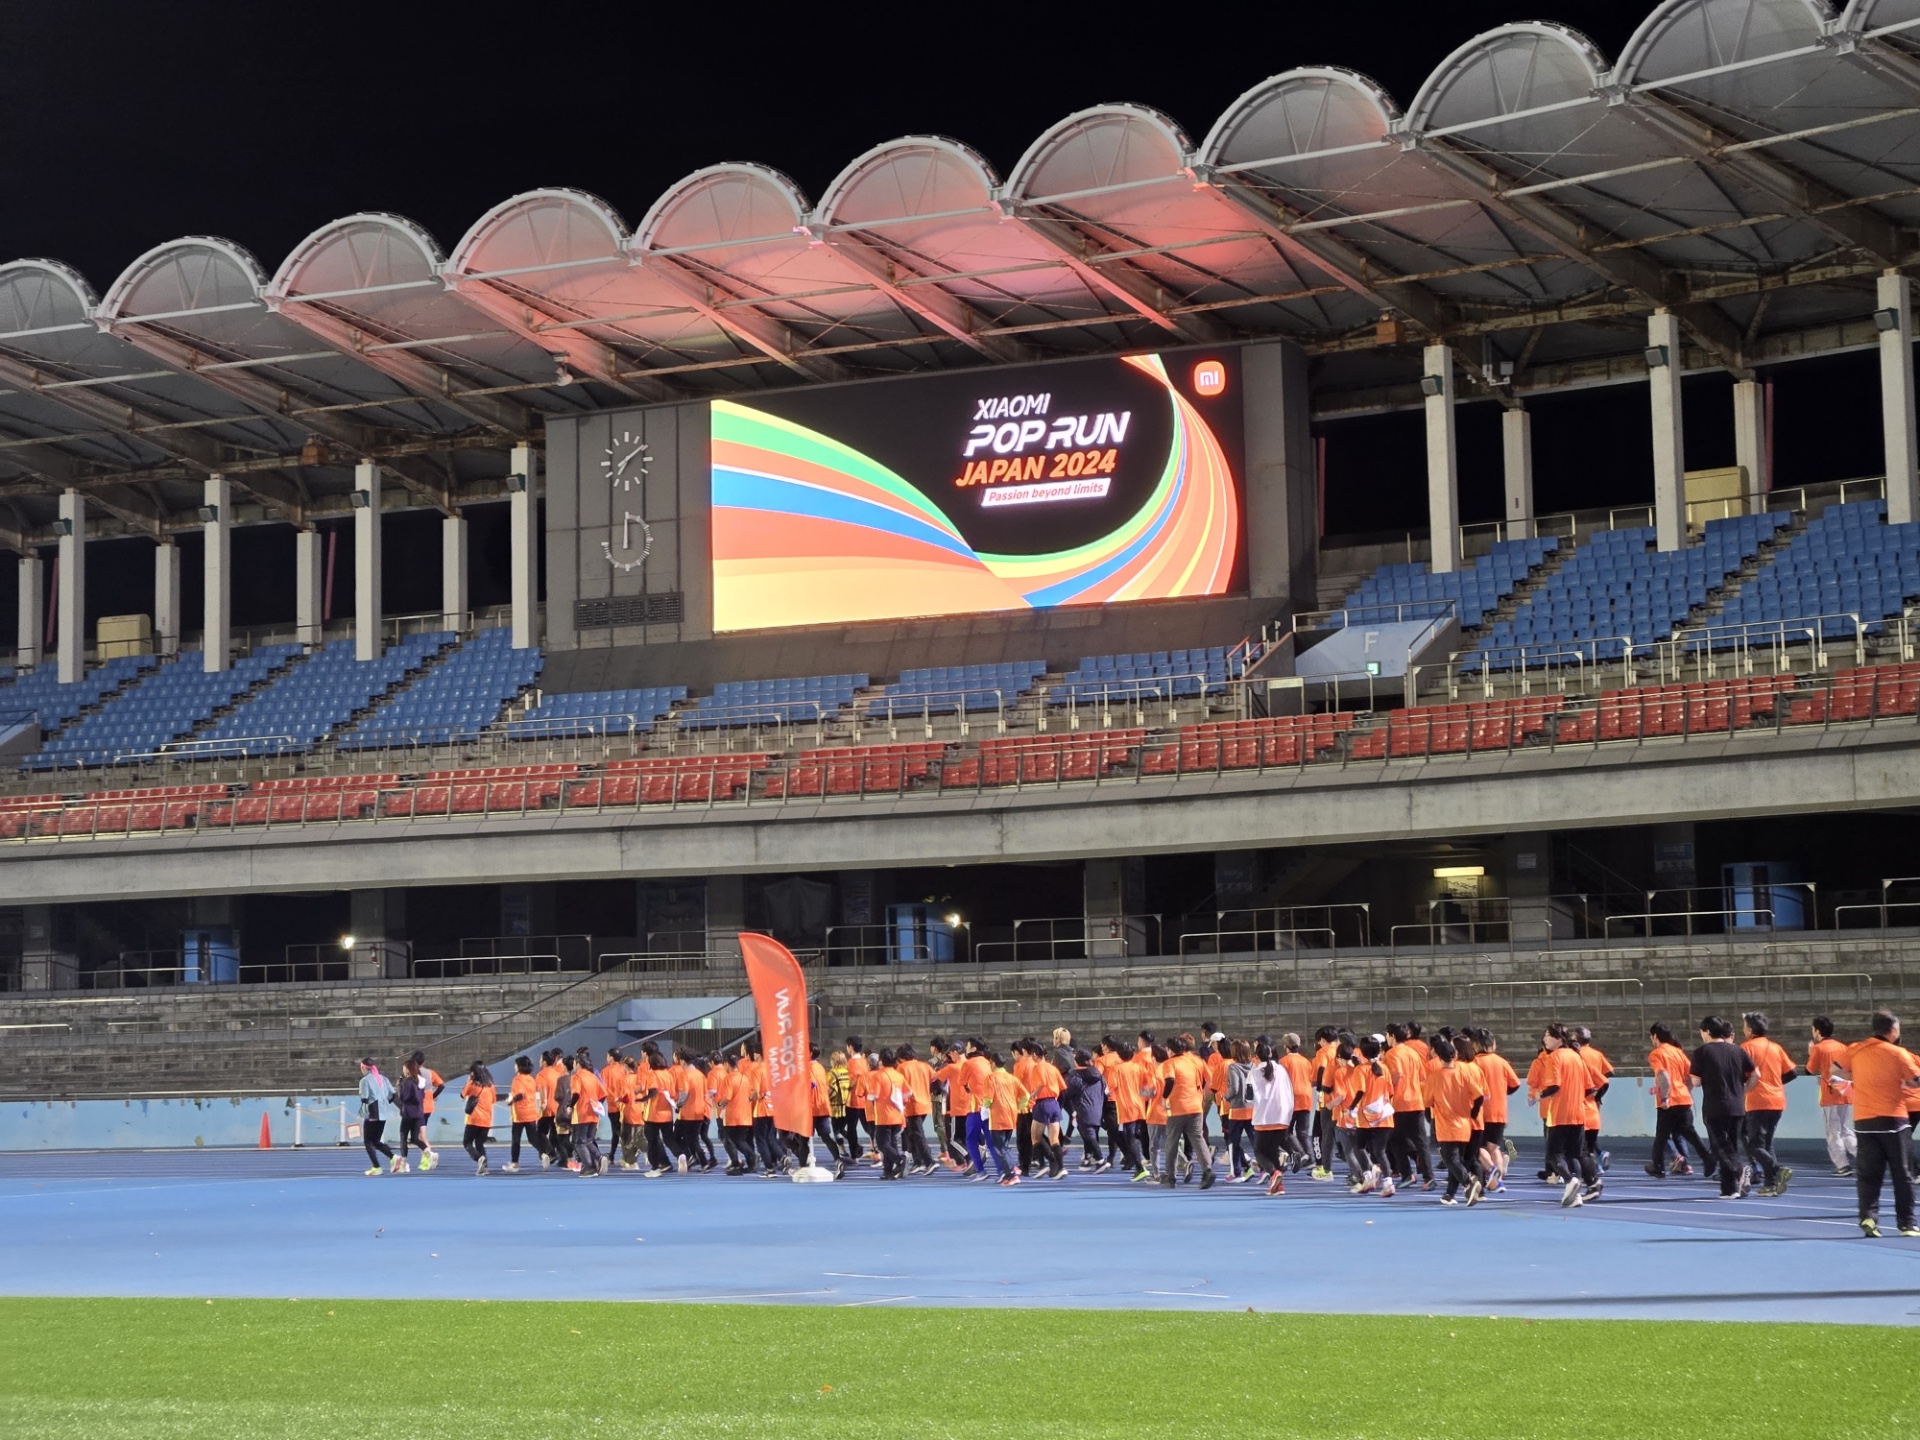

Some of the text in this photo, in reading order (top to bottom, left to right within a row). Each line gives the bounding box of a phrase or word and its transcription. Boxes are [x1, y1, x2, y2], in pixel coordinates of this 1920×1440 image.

[973, 392, 1051, 420] XIAOMI
[963, 411, 1131, 457] POP RUN
[955, 449, 1117, 486] JAPAN 2024
[988, 481, 1103, 503] Passion beyond limits
[1364, 631, 1379, 653] F
